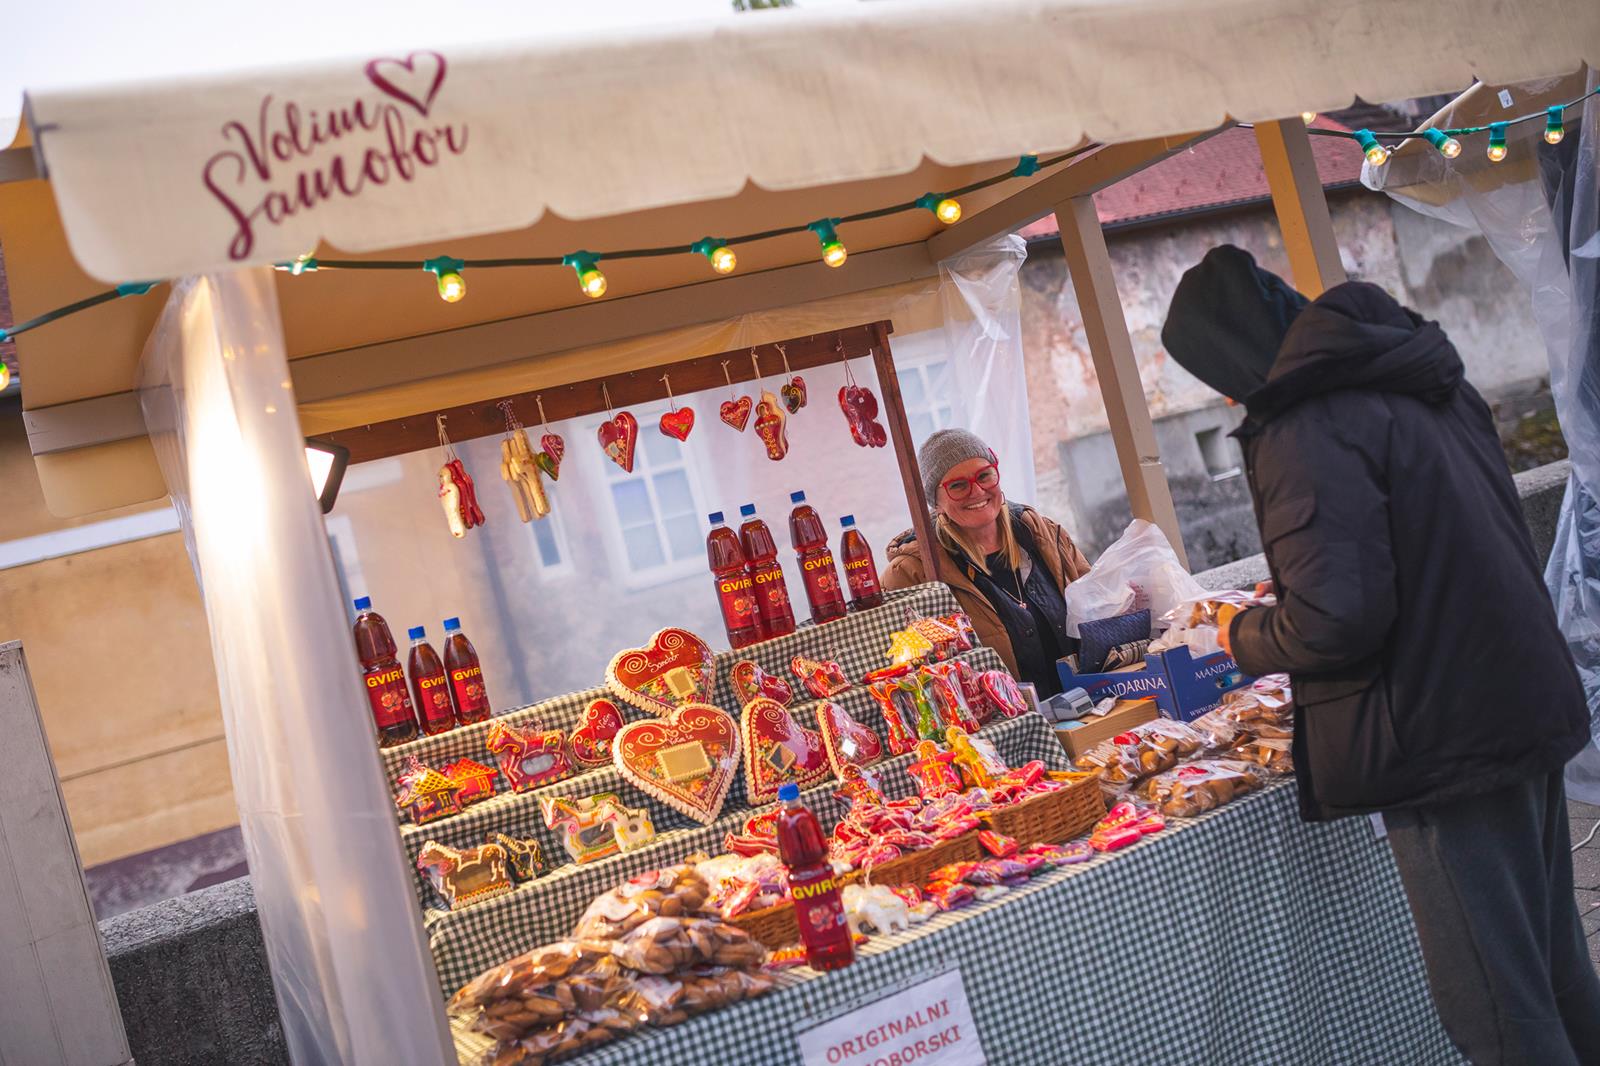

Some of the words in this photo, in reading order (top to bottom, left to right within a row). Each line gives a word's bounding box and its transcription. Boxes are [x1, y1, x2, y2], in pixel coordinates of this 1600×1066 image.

[221, 93, 381, 181] Volim
[202, 104, 469, 261] Samobor
[842, 559, 870, 570] VIRC
[826, 999, 951, 1064] ORIGINALNI
